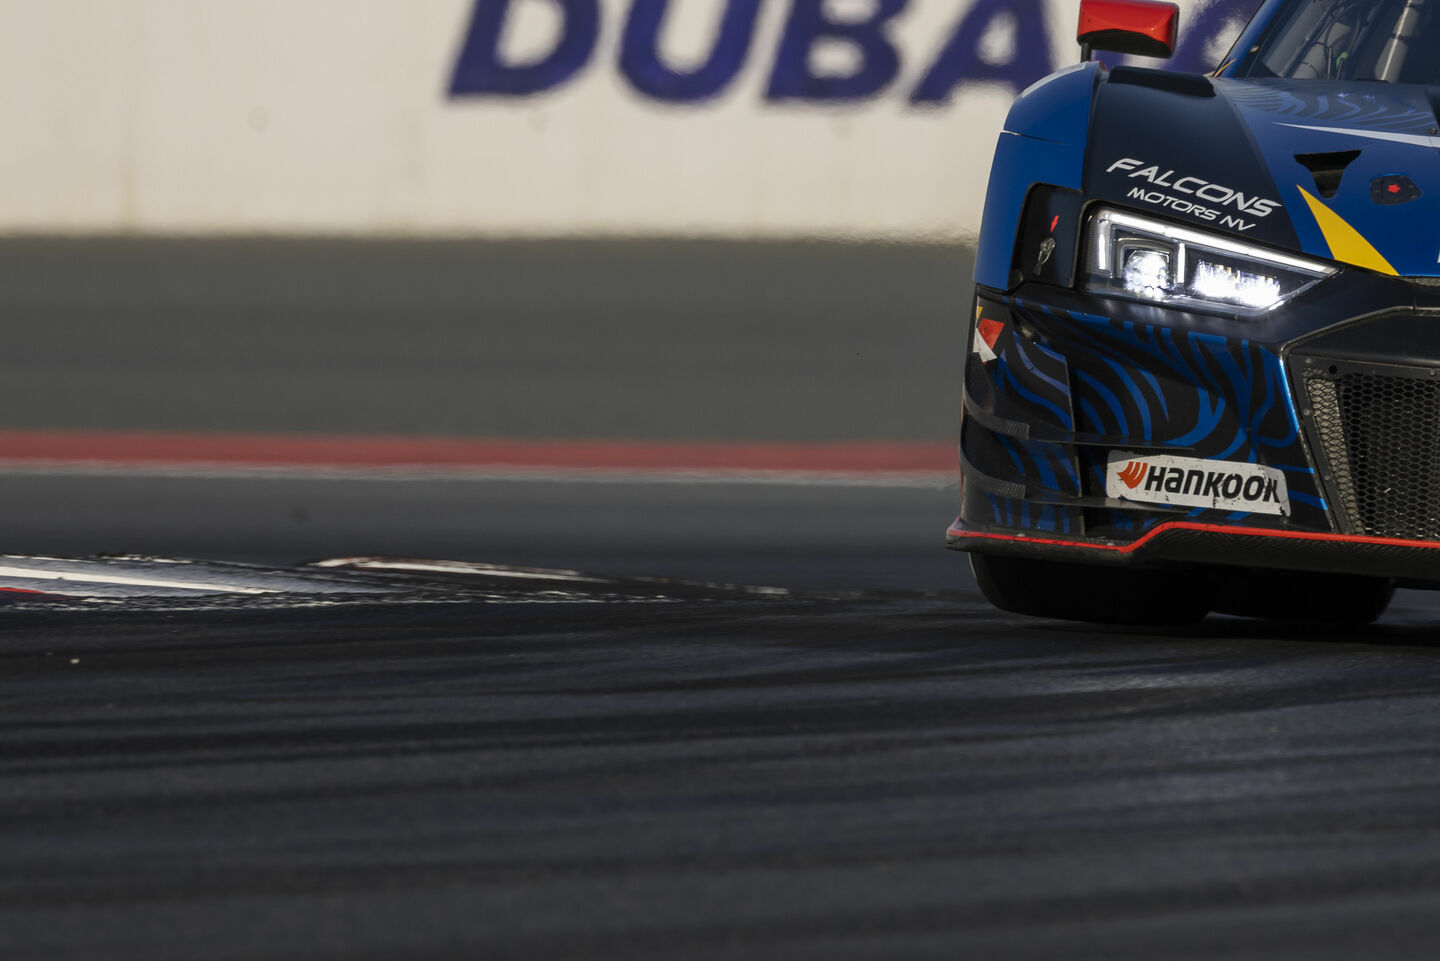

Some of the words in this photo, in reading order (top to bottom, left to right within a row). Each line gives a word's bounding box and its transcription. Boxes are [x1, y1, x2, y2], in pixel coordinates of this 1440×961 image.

[1106, 157, 1283, 217] FALCONS
[1127, 187, 1222, 221] MOTORS
[1219, 215, 1257, 231] NV
